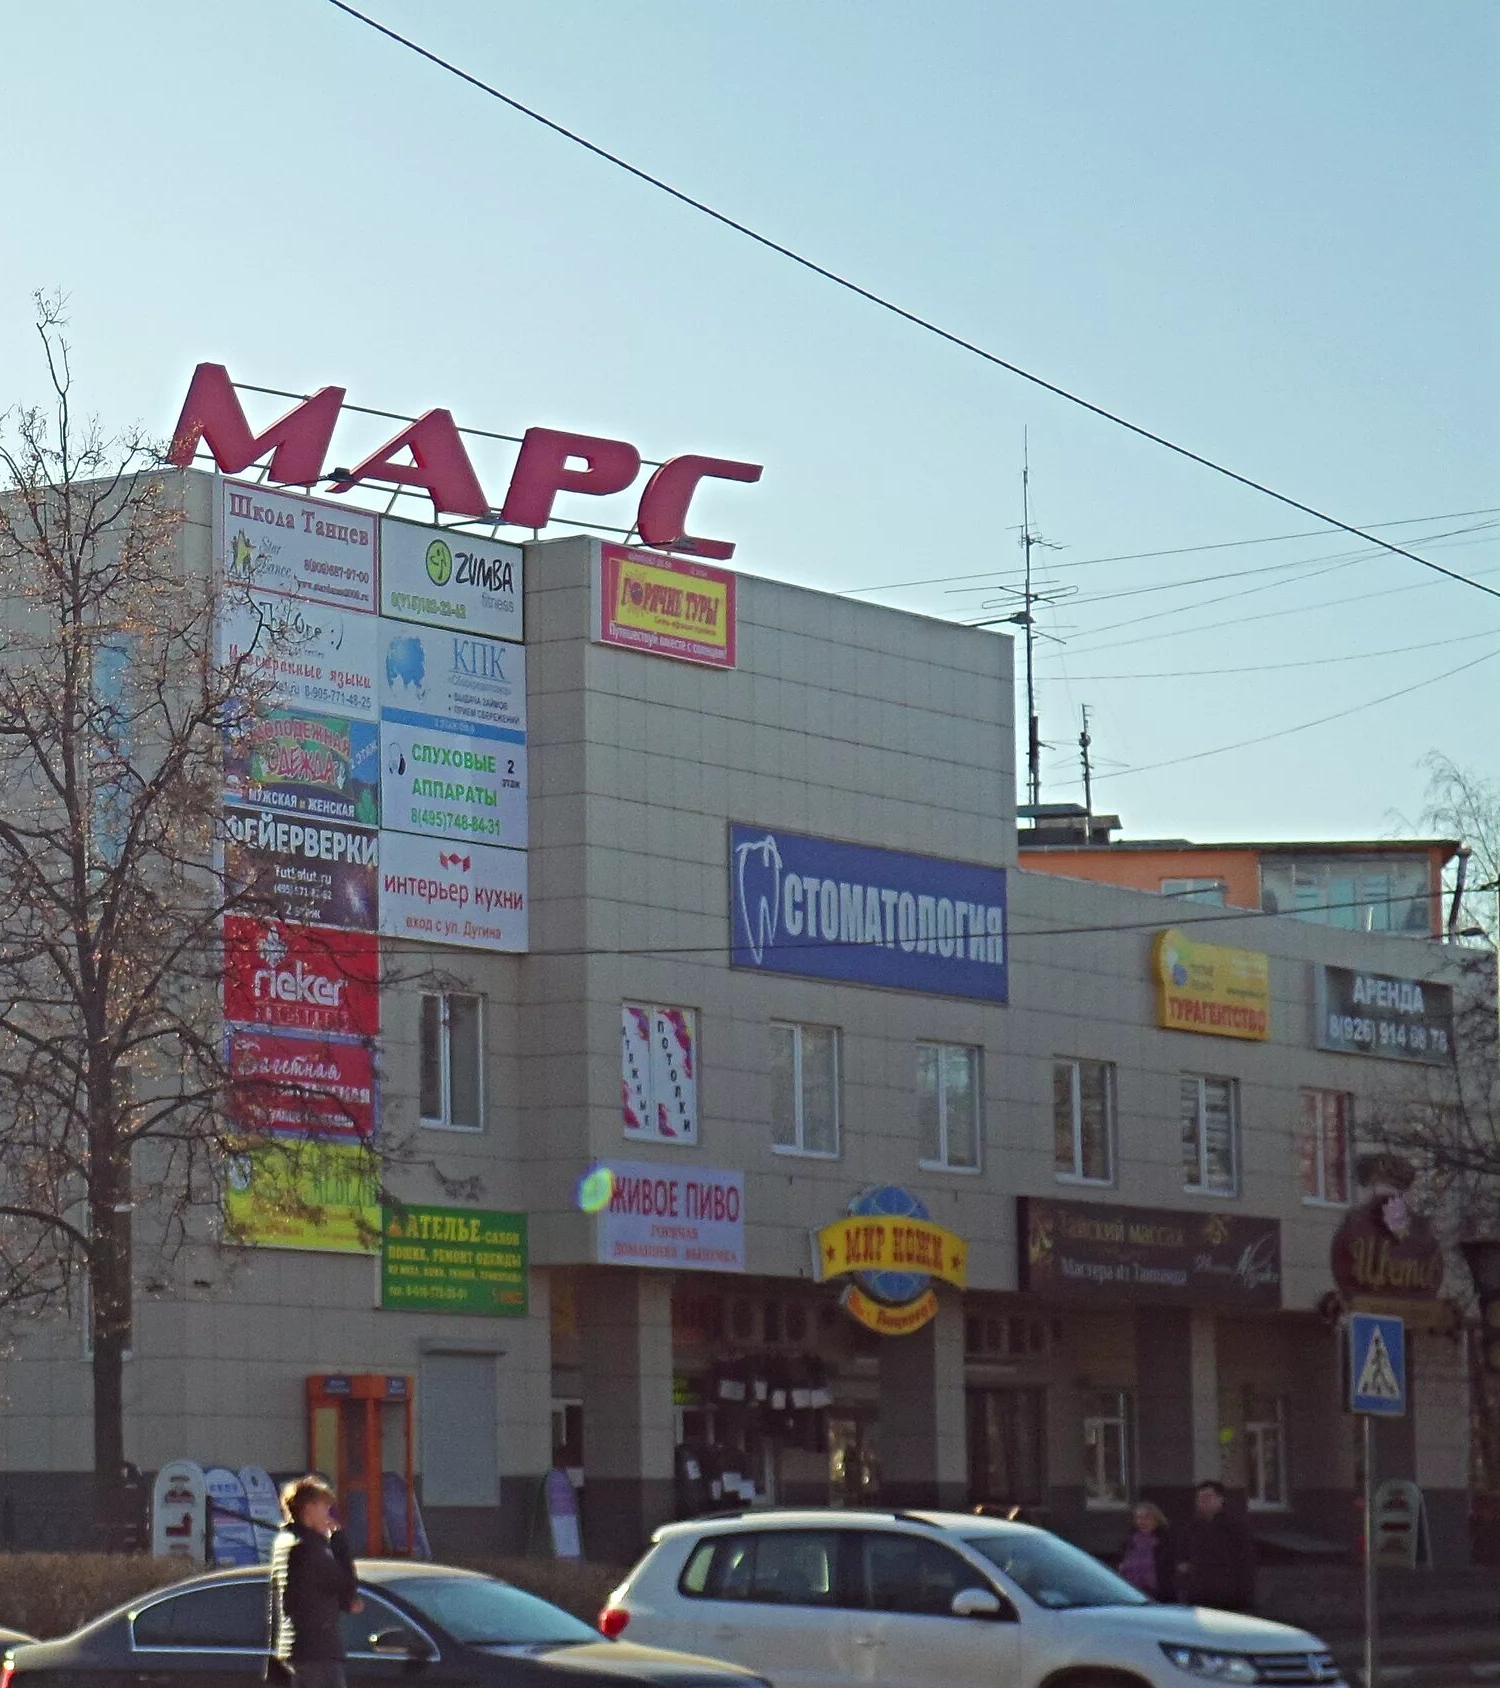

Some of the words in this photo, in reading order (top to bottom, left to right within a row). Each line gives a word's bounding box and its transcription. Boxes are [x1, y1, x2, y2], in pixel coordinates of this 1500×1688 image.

[167, 361, 764, 560] МАРС
[230, 492, 295, 529] Школа
[302, 508, 369, 546] Танцев
[455, 552, 514, 594] ZUMBA
[686, 592, 720, 626] ТУРЫ
[452, 638, 506, 680] КПК
[412, 742, 496, 774] СЛУХОВЫЕ
[508, 760, 514, 774] 2
[249, 788, 296, 808] МУЖСКАЯ
[308, 798, 355, 817] ЖЕНСКАЯ
[412, 777, 497, 807] АППАРАТЫ
[226, 812, 378, 866] ФЕЙЕРВЕРКИ
[385, 874, 469, 909] интерьер
[475, 886, 523, 912] кухни
[406, 916, 432, 931] вход
[784, 872, 1003, 964] СТОМАТОЛОГИЯ
[255, 960, 347, 1006] rieker
[1353, 976, 1424, 1014] АРЕНДА
[1170, 996, 1266, 1032] ТУРАГЕНТСТВО
[610, 1176, 678, 1216] ЖИВОЕ
[687, 1182, 740, 1222] ПИВО
[846, 1226, 885, 1264] МИР
